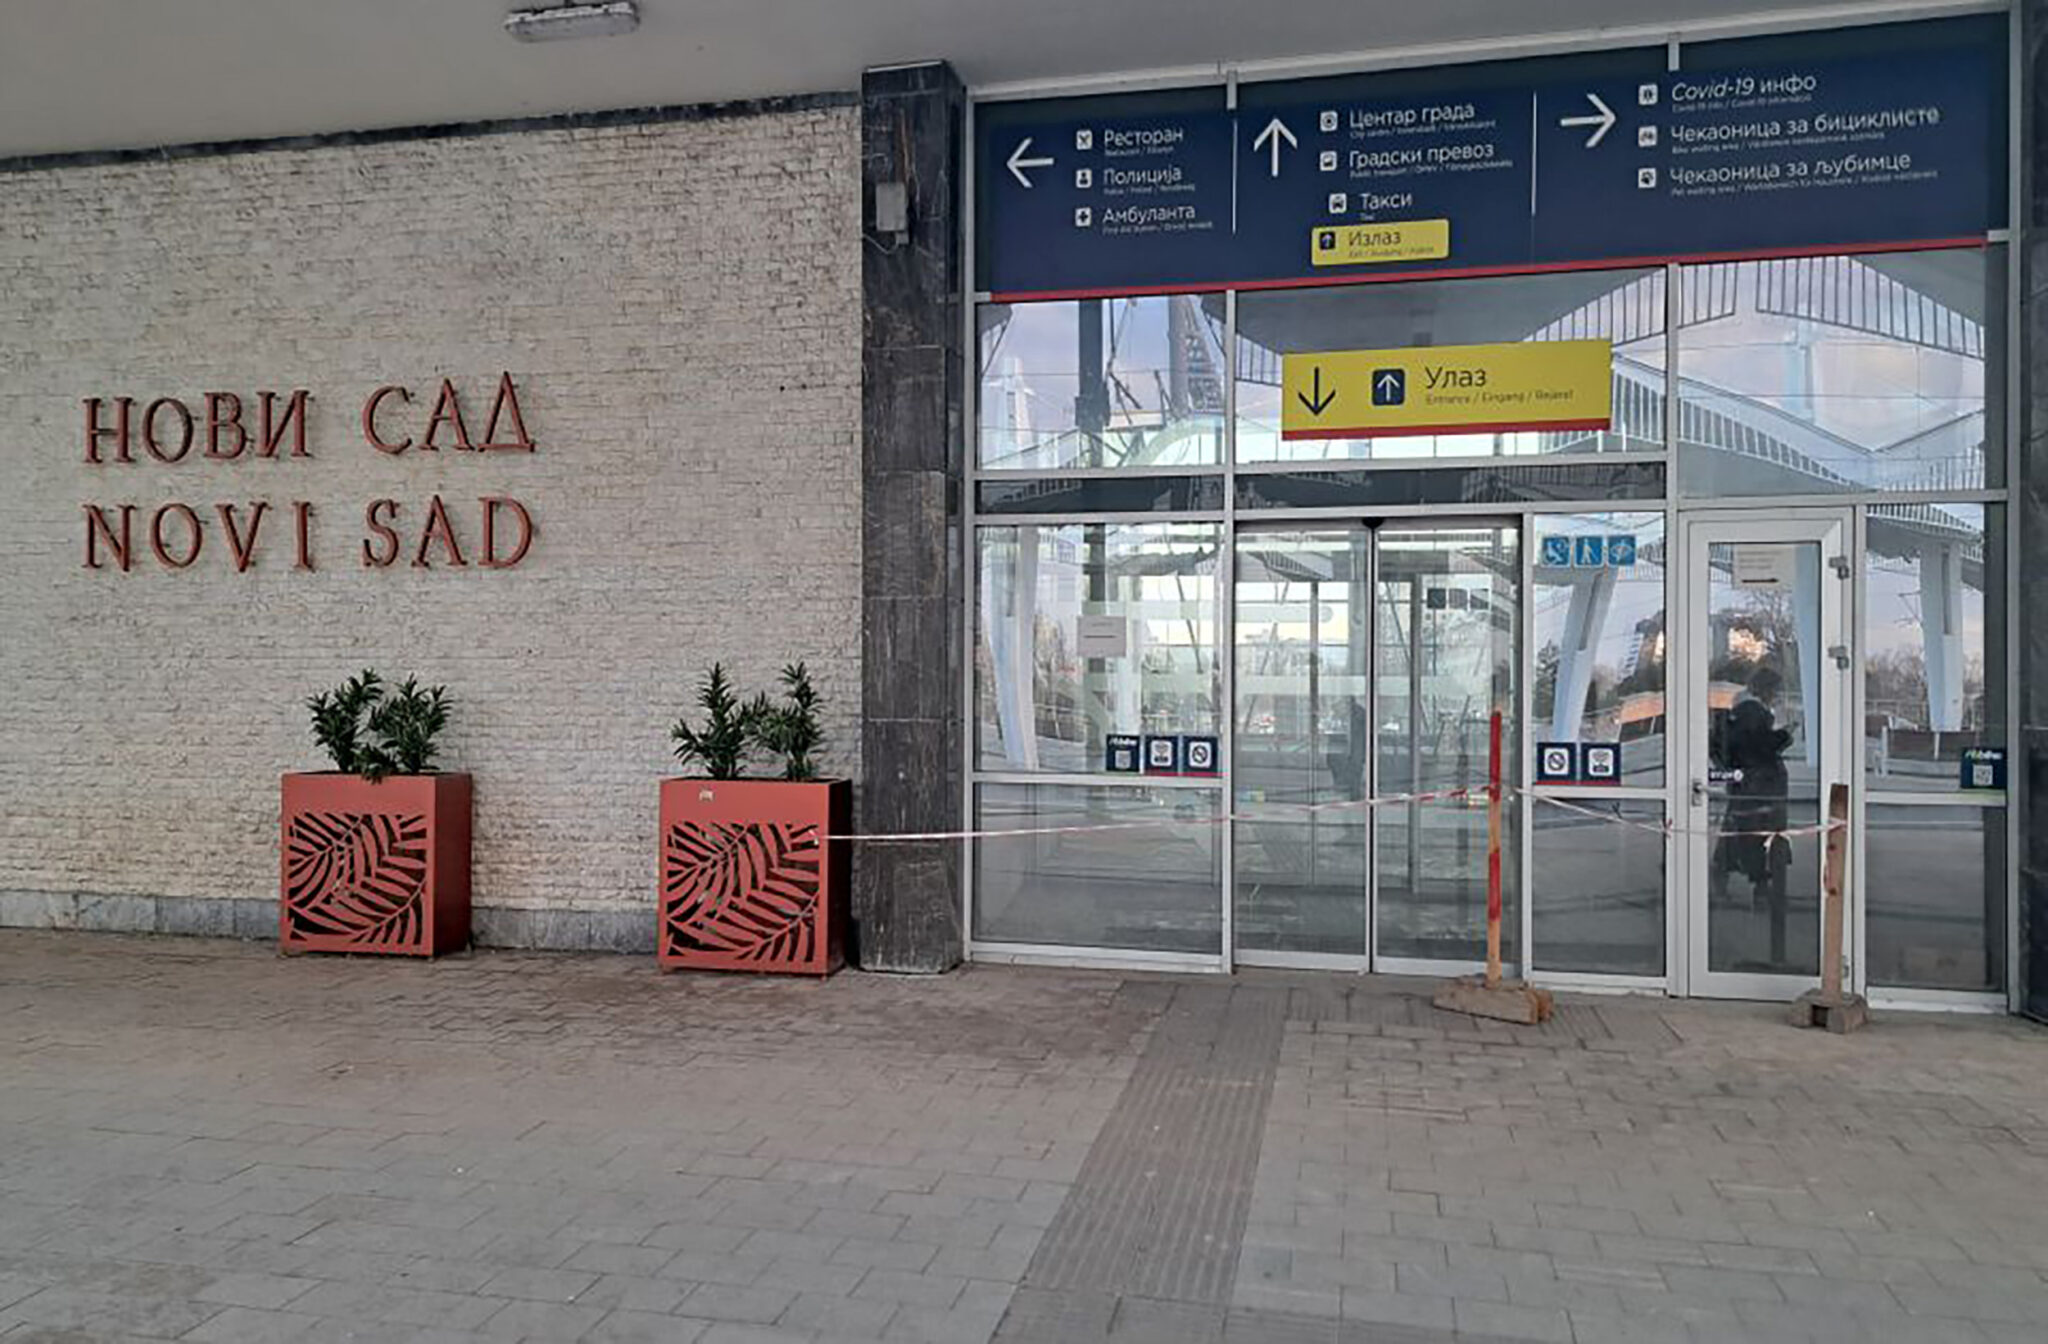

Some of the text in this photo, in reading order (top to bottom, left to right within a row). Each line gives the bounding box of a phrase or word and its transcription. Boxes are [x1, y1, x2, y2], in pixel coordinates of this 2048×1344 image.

[1671, 74, 1817, 101] Covid-19 инфо
[1350, 109, 1415, 130] Центар
[1422, 103, 1476, 122] града
[1670, 121, 1780, 142] Чекаоница
[1786, 119, 1808, 134] за
[1814, 106, 1940, 131] бициклисте
[1103, 128, 1184, 146] Ресторан
[1350, 149, 1422, 169] Градски
[1427, 143, 1495, 163] превоз
[1670, 164, 1780, 184] Чекаоница
[1786, 161, 1808, 176] за
[1814, 154, 1911, 177] љубимце
[1103, 165, 1183, 184] Полиција
[1360, 192, 1412, 210] Такси
[1102, 205, 1196, 225] Амбуланта
[1348, 231, 1402, 247] Излаз
[1424, 366, 1488, 389] Улаз
[82, 371, 536, 463] НОВИ САД
[82, 495, 534, 572] NOVI SAD
